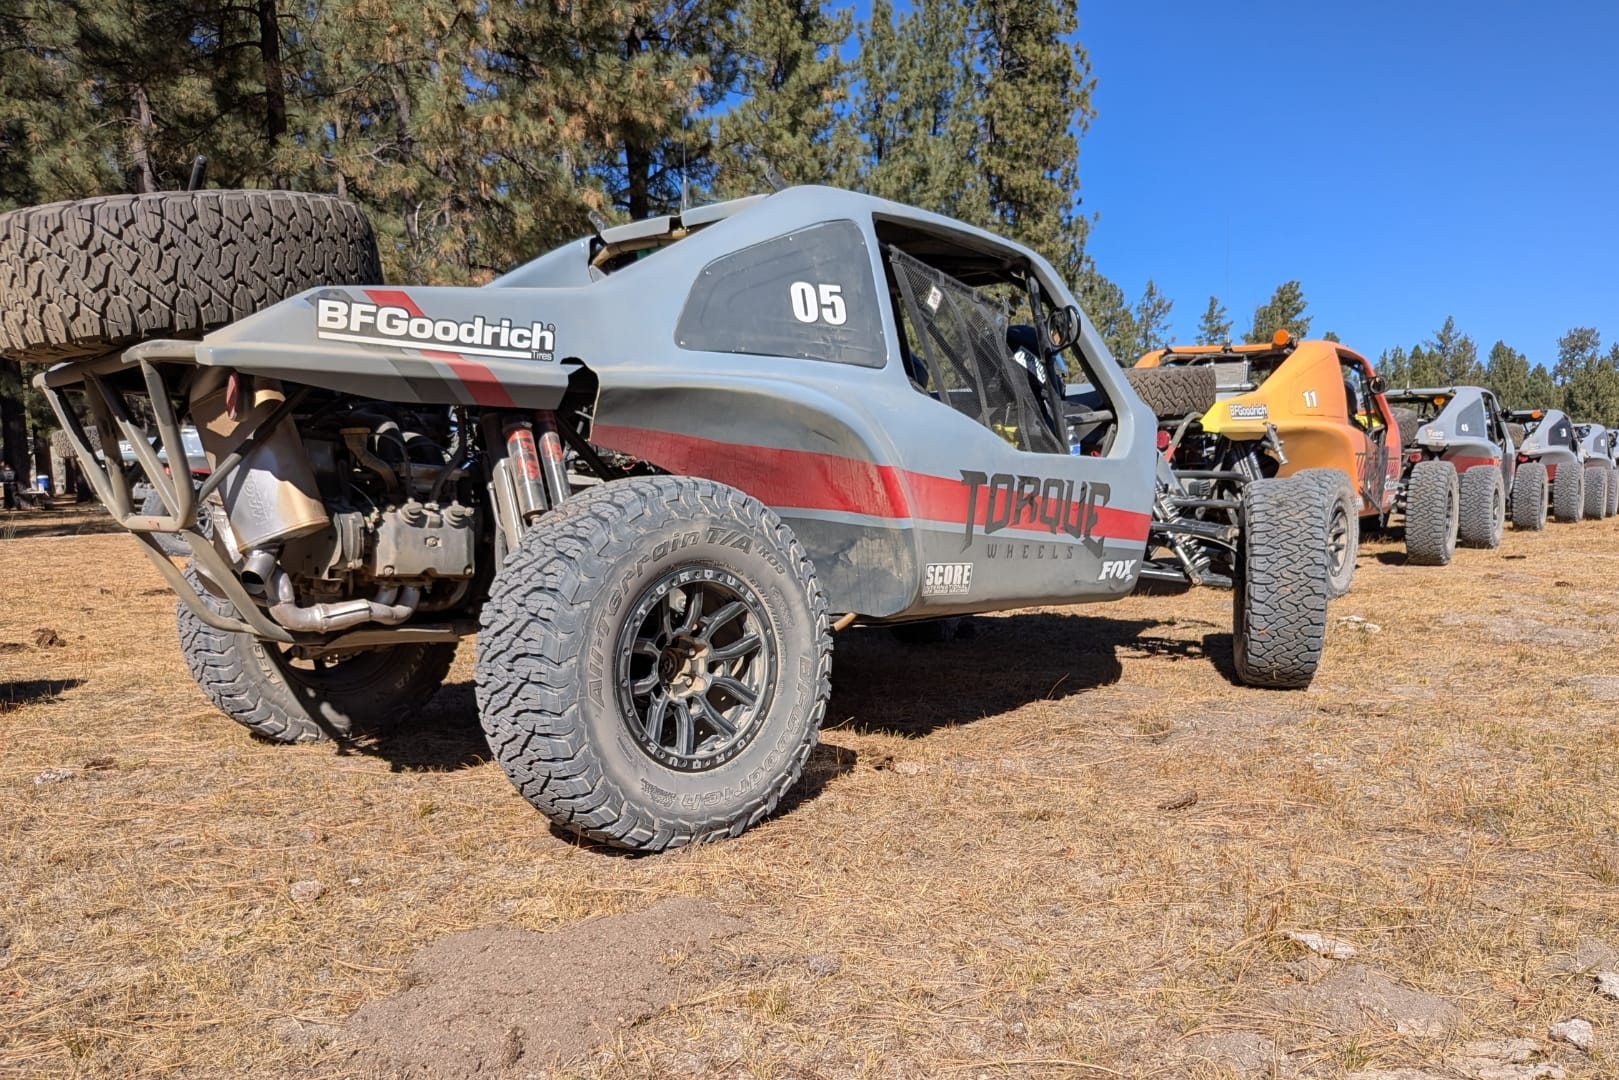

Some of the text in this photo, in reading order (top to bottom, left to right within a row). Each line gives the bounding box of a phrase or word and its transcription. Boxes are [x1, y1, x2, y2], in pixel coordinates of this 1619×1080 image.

[790, 281, 847, 326] 05
[318, 299, 555, 350] BFGoodrich
[531, 351, 553, 360] Tires
[1303, 391, 1318, 408] 11
[960, 470, 1111, 559] TORQUE
[707, 526, 752, 554] T/A
[987, 543, 1074, 560] WHEELS
[926, 565, 971, 585] SCORE
[1098, 559, 1138, 581] FOX
